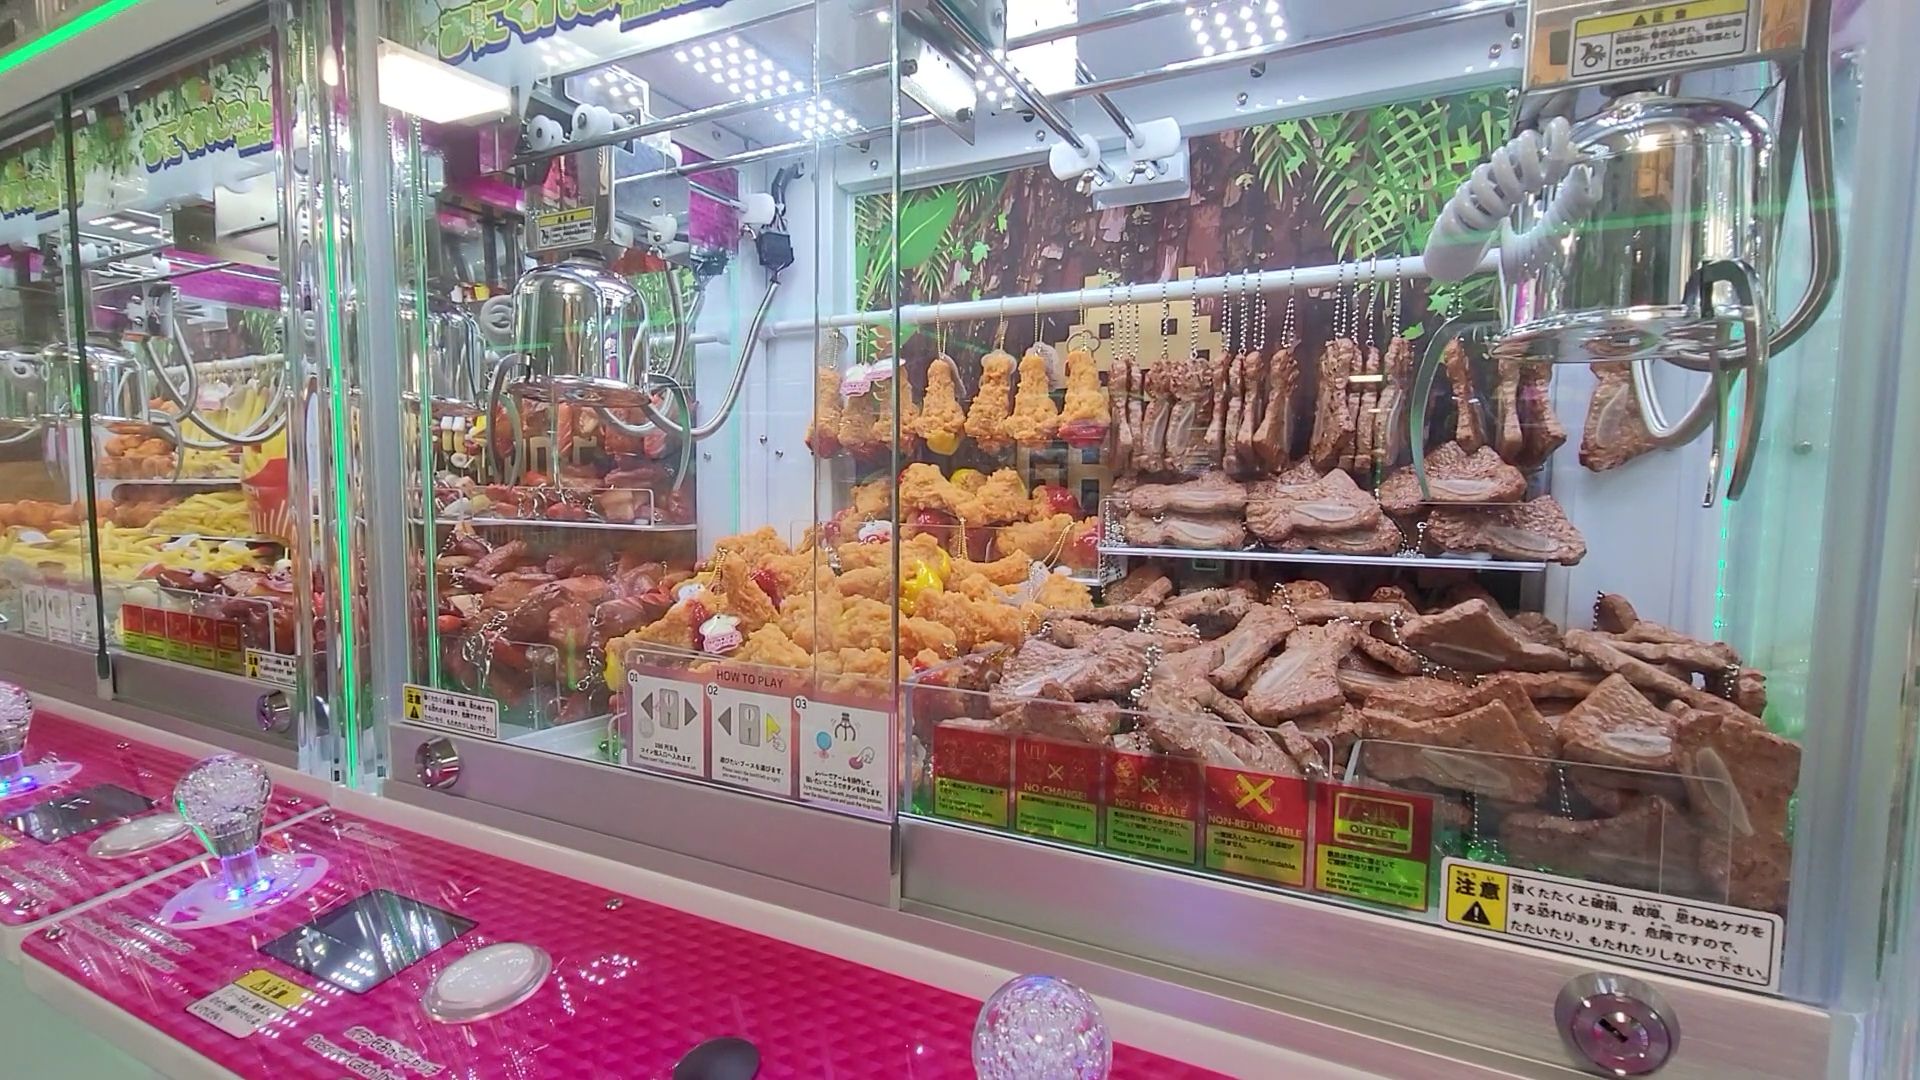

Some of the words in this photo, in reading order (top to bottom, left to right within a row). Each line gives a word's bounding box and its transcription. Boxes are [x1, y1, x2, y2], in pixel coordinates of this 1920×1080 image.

[629, 672, 638, 683] 01
[716, 669, 740, 681] HOW
[742, 673, 756, 684] TO
[758, 675, 784, 688] PLAY
[707, 685, 718, 696] 02
[795, 698, 807, 709] 03
[1023, 782, 1040, 793] NO
[1115, 797, 1136, 809] NOT
[1140, 802, 1159, 813] FOR
[1161, 805, 1187, 818] SALE
[1208, 815, 1303, 837] NON-REFUNDABLE
[1350, 824, 1397, 840] OUTLET
[1456, 876, 1500, 900] 注意
[1512, 882, 1765, 938] 強くたたくと破損、故障、思わぬケガを
[1512, 902, 1738, 954] する恐れがあります。危険ですので、
[1511, 920, 1767, 981] たたいたり、もたれたりしないで下さい。
